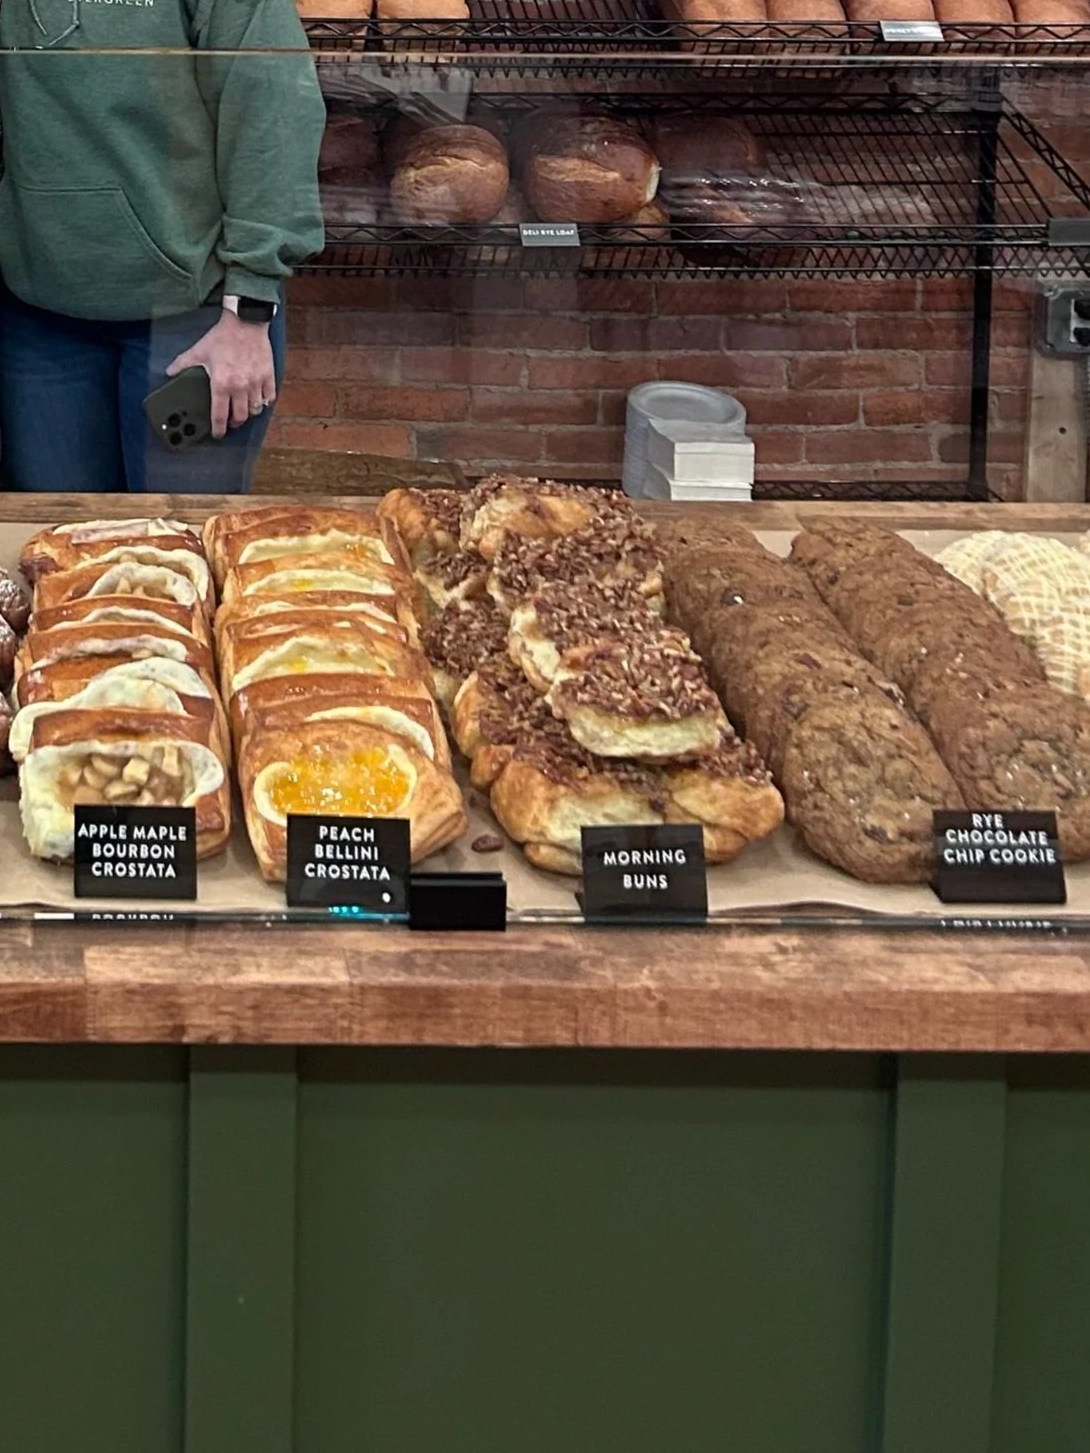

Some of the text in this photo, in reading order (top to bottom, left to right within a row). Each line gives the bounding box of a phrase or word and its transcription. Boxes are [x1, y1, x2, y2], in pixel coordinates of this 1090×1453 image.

[971, 813, 1004, 829] RYE
[77, 823, 187, 842] APPLE MAPLE
[318, 825, 375, 843] PEACH
[945, 828, 1049, 846] CHOCOLATE
[92, 842, 175, 860] BOURBON
[314, 844, 379, 861] BELLINI
[603, 848, 687, 866] MORNING
[943, 848, 1056, 864] CHIP COOKIE
[91, 861, 177, 878] CROSTATA
[304, 862, 391, 881] CROSTATA
[622, 873, 668, 890] BUNS
